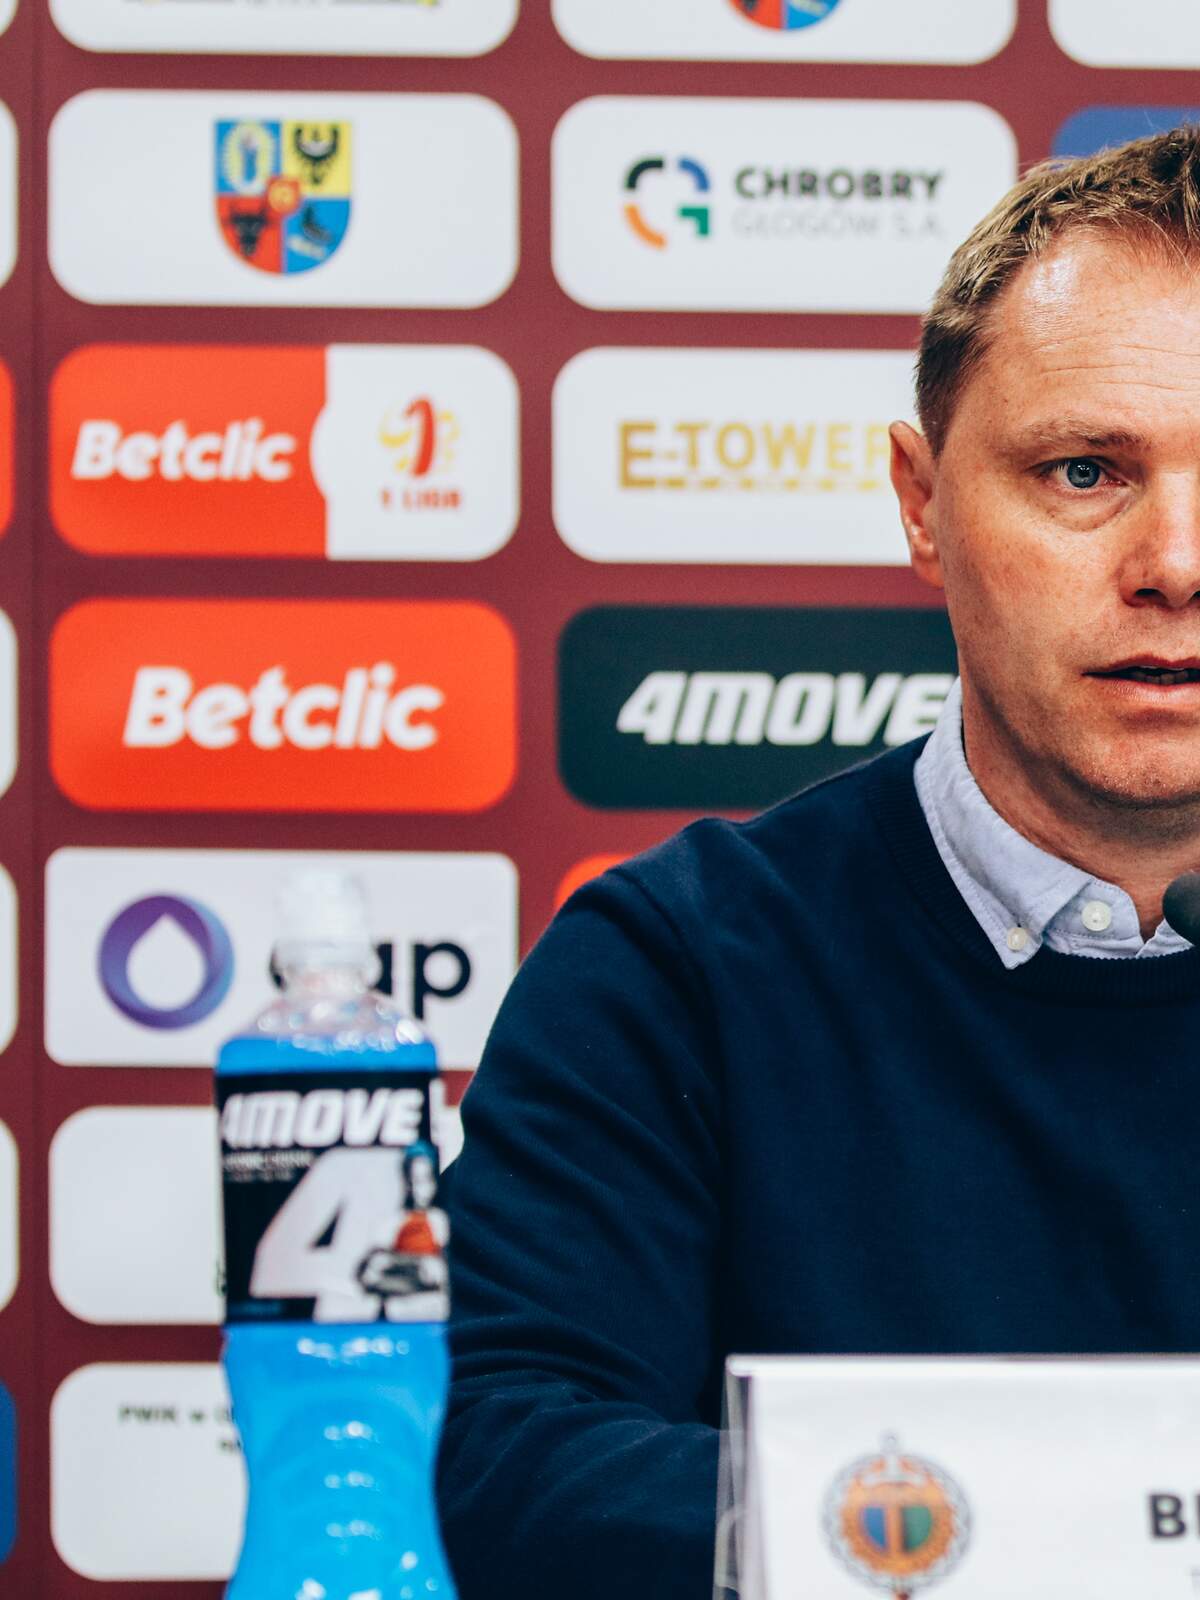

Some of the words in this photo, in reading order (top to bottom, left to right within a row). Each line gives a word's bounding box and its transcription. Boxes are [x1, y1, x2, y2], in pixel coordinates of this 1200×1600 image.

[735, 167, 943, 200] CHROBRY
[72, 418, 295, 481] Betclic
[619, 420, 891, 490] E-TOWER
[122, 660, 445, 750] Betclic
[615, 670, 957, 746] 4MOVE
